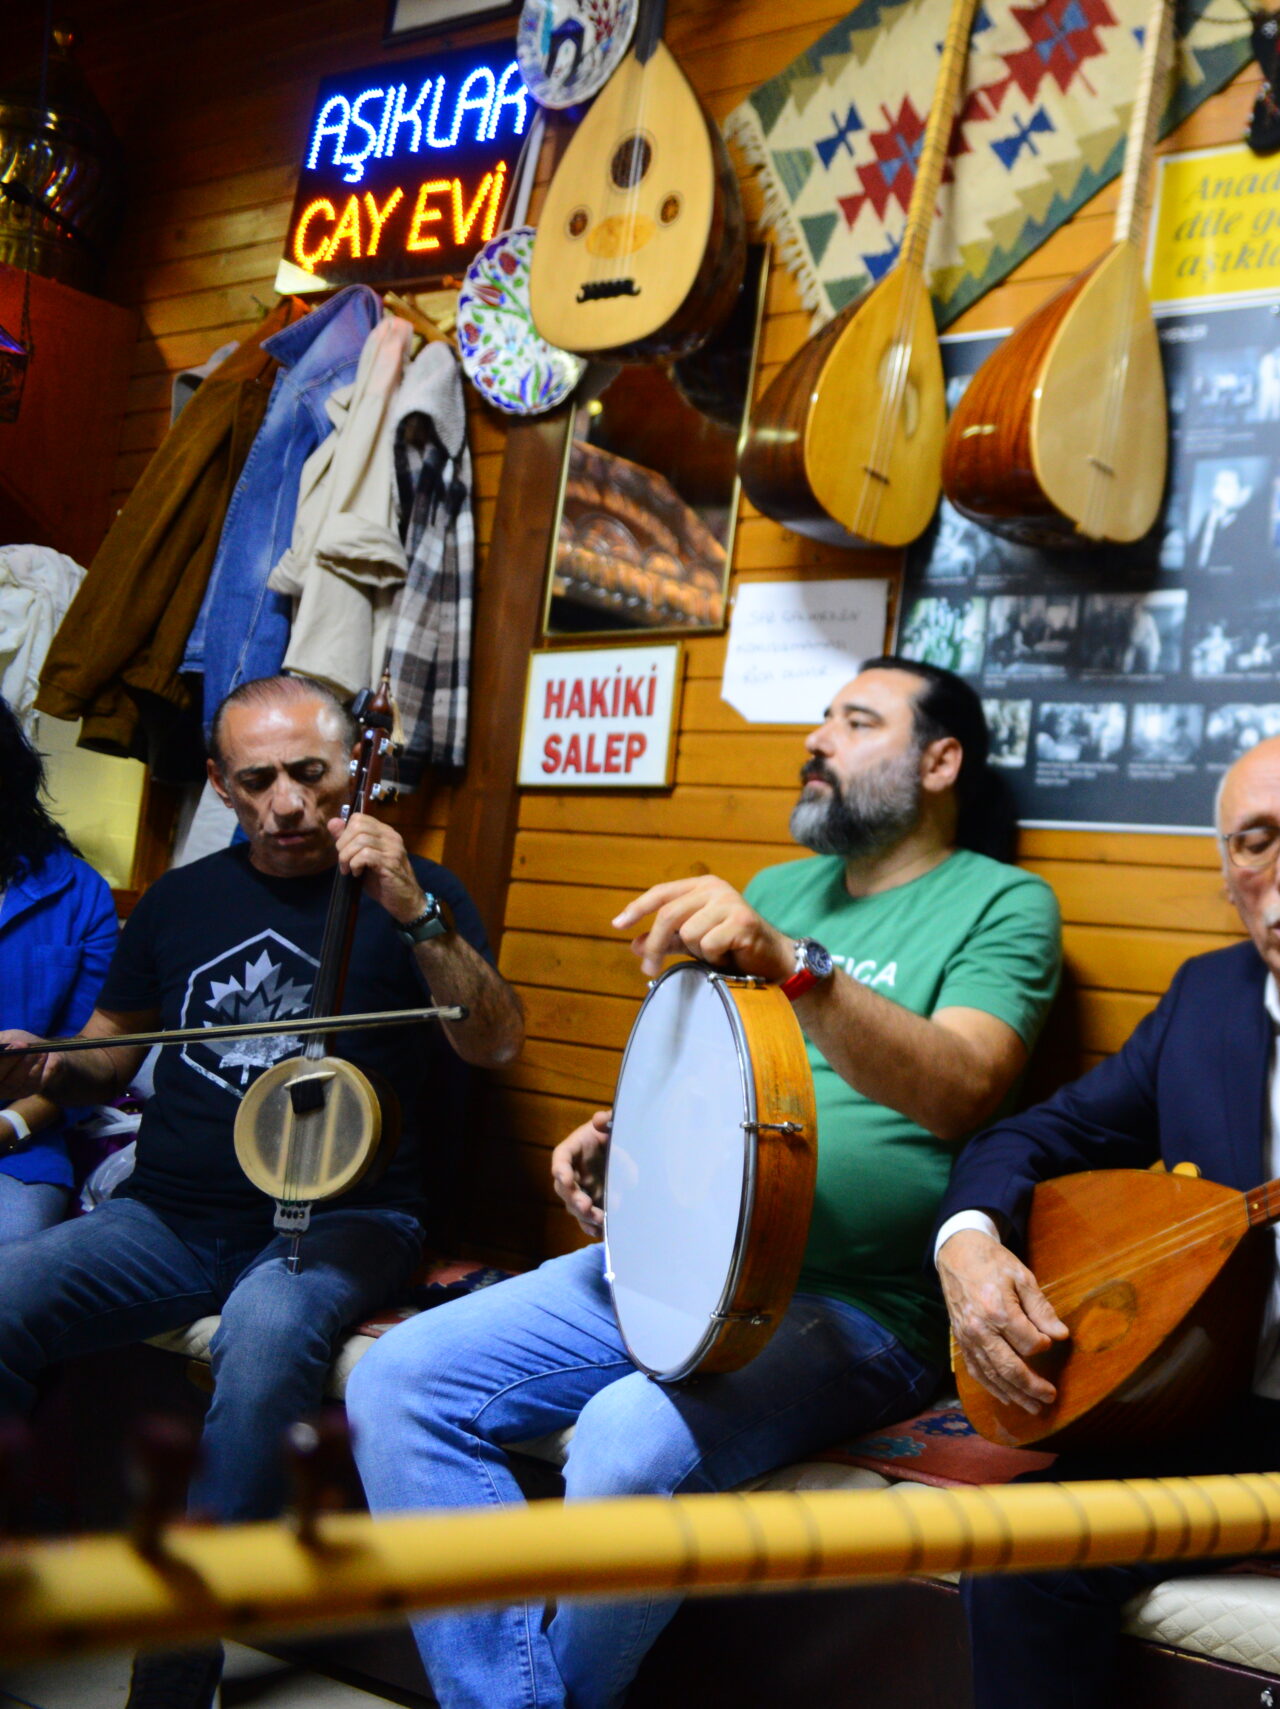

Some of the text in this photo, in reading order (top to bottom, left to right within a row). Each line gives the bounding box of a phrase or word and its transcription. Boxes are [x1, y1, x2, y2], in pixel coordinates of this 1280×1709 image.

[305, 61, 528, 183] AŞIKLAR
[406, 161, 507, 252] EVİ
[1172, 207, 1244, 243] dile
[543, 664, 657, 719] HAKİKİ
[541, 732, 648, 775] SALEP
